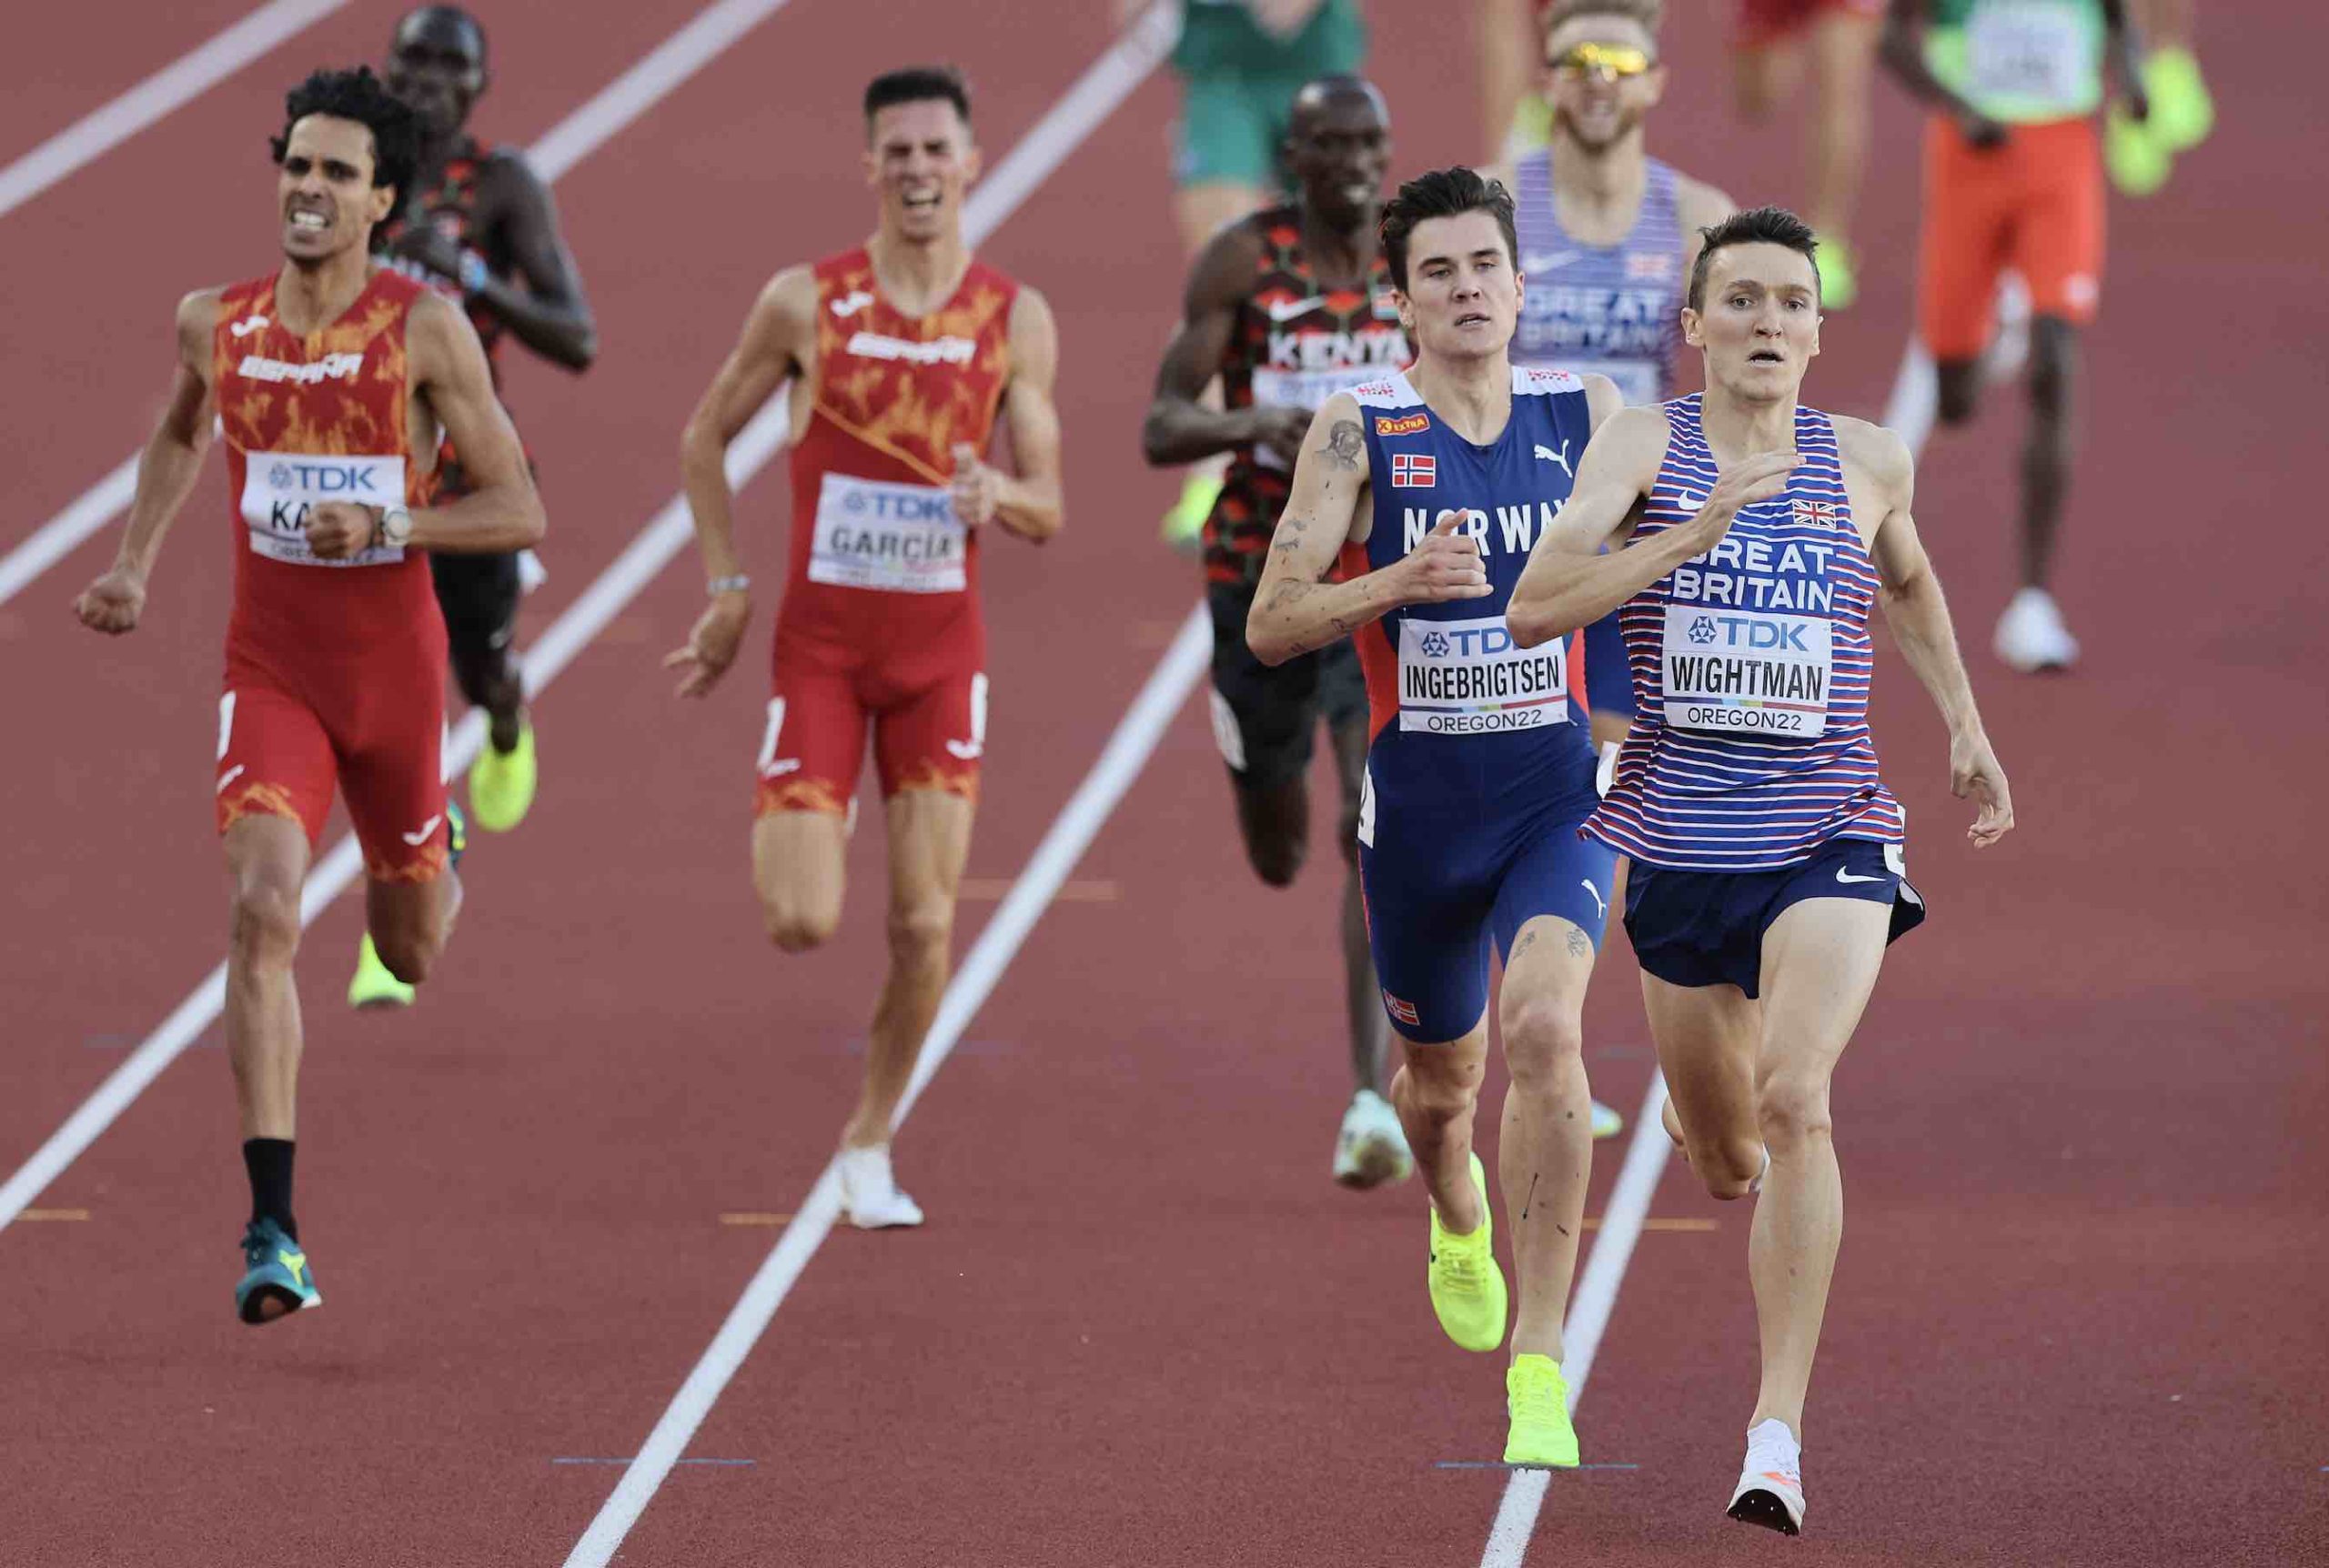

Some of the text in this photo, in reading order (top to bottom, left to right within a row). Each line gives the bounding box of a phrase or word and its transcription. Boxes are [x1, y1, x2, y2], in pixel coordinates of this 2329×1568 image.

[1267, 328, 1411, 368] KENYA
[291, 464, 377, 491] TDK
[875, 492, 951, 524] TDK
[1403, 498, 1571, 557] NRWA
[1672, 568, 1833, 613] BRITAIN
[1449, 627, 1519, 657] TD
[1717, 617, 1810, 652] TDK
[1406, 655, 1559, 699] INGEBRIGTSEN
[1671, 656, 1823, 701] WIGHTMAN
[1427, 709, 1542, 732] OREGON22
[1688, 707, 1802, 731] OREGON22
